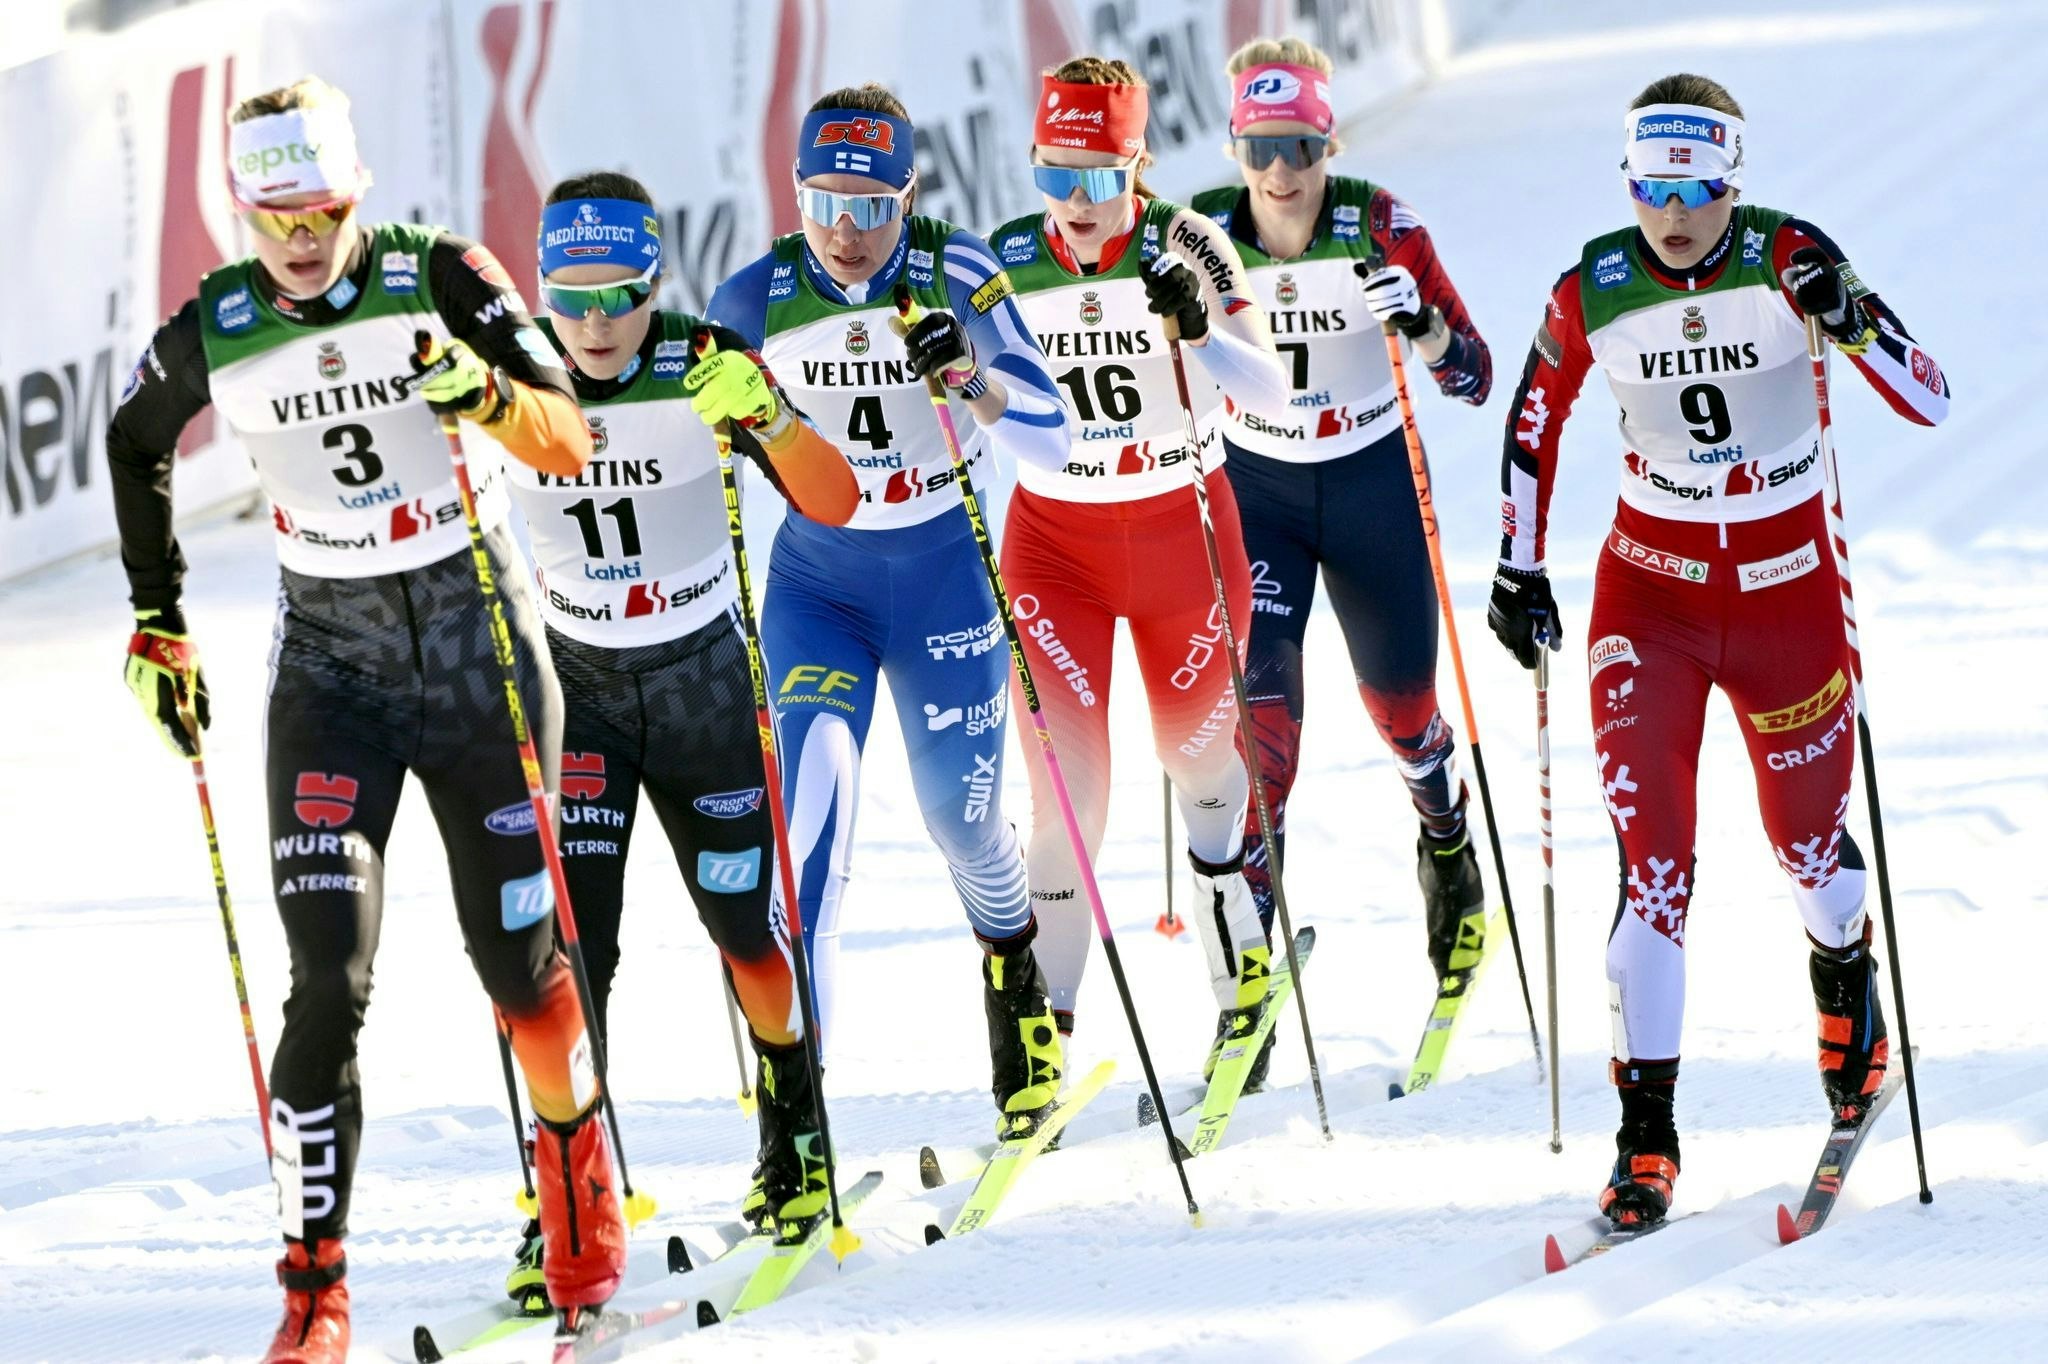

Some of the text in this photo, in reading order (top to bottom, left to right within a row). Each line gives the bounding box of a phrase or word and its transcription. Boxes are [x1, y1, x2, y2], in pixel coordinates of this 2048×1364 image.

[1242, 79, 1281, 99] JFJ
[1637, 120, 1710, 138] SpareBank
[1005, 254, 1032, 263] coop
[1172, 220, 1233, 293] helvetia
[1599, 271, 1626, 284] coop
[1038, 330, 1151, 357] VELTINS
[653, 360, 685, 374] coop
[688, 358, 724, 386] Roeckl
[802, 360, 922, 387] VELTINS
[1275, 342, 1309, 390] 7
[1639, 342, 1759, 379] VELTINS
[271, 375, 411, 425] VELTINS
[1056, 364, 1142, 422] 16
[1290, 390, 1331, 408] ahti
[847, 395, 893, 450] 4
[1244, 412, 1305, 440] Sievi
[1680, 383, 1733, 445] 9
[322, 423, 384, 488] 3
[1688, 444, 1743, 464] Lahti
[1768, 439, 1819, 488] Sievi
[956, 474, 987, 543] LEKI
[562, 498, 642, 559] 11
[1616, 538, 1681, 573] SPAR
[1747, 553, 1813, 584] Scandic
[584, 561, 642, 581] Lahti
[549, 588, 613, 622] Sievi
[670, 559, 728, 609] Sievi
[1250, 598, 1294, 616] ffler
[1028, 618, 1096, 708] Sunrise
[1592, 639, 1630, 665] Gilde
[779, 664, 860, 695] FF
[776, 695, 856, 713] FINNFORM
[1763, 687, 1840, 730] DHL
[1766, 713, 1848, 771] CRAFT
[699, 791, 757, 807] personal
[711, 802, 744, 814] shop
[560, 806, 626, 828] ÜRTH
[274, 831, 372, 863] WÜRTH
[565, 840, 619, 856] TERREX
[297, 874, 367, 894] TERREX
